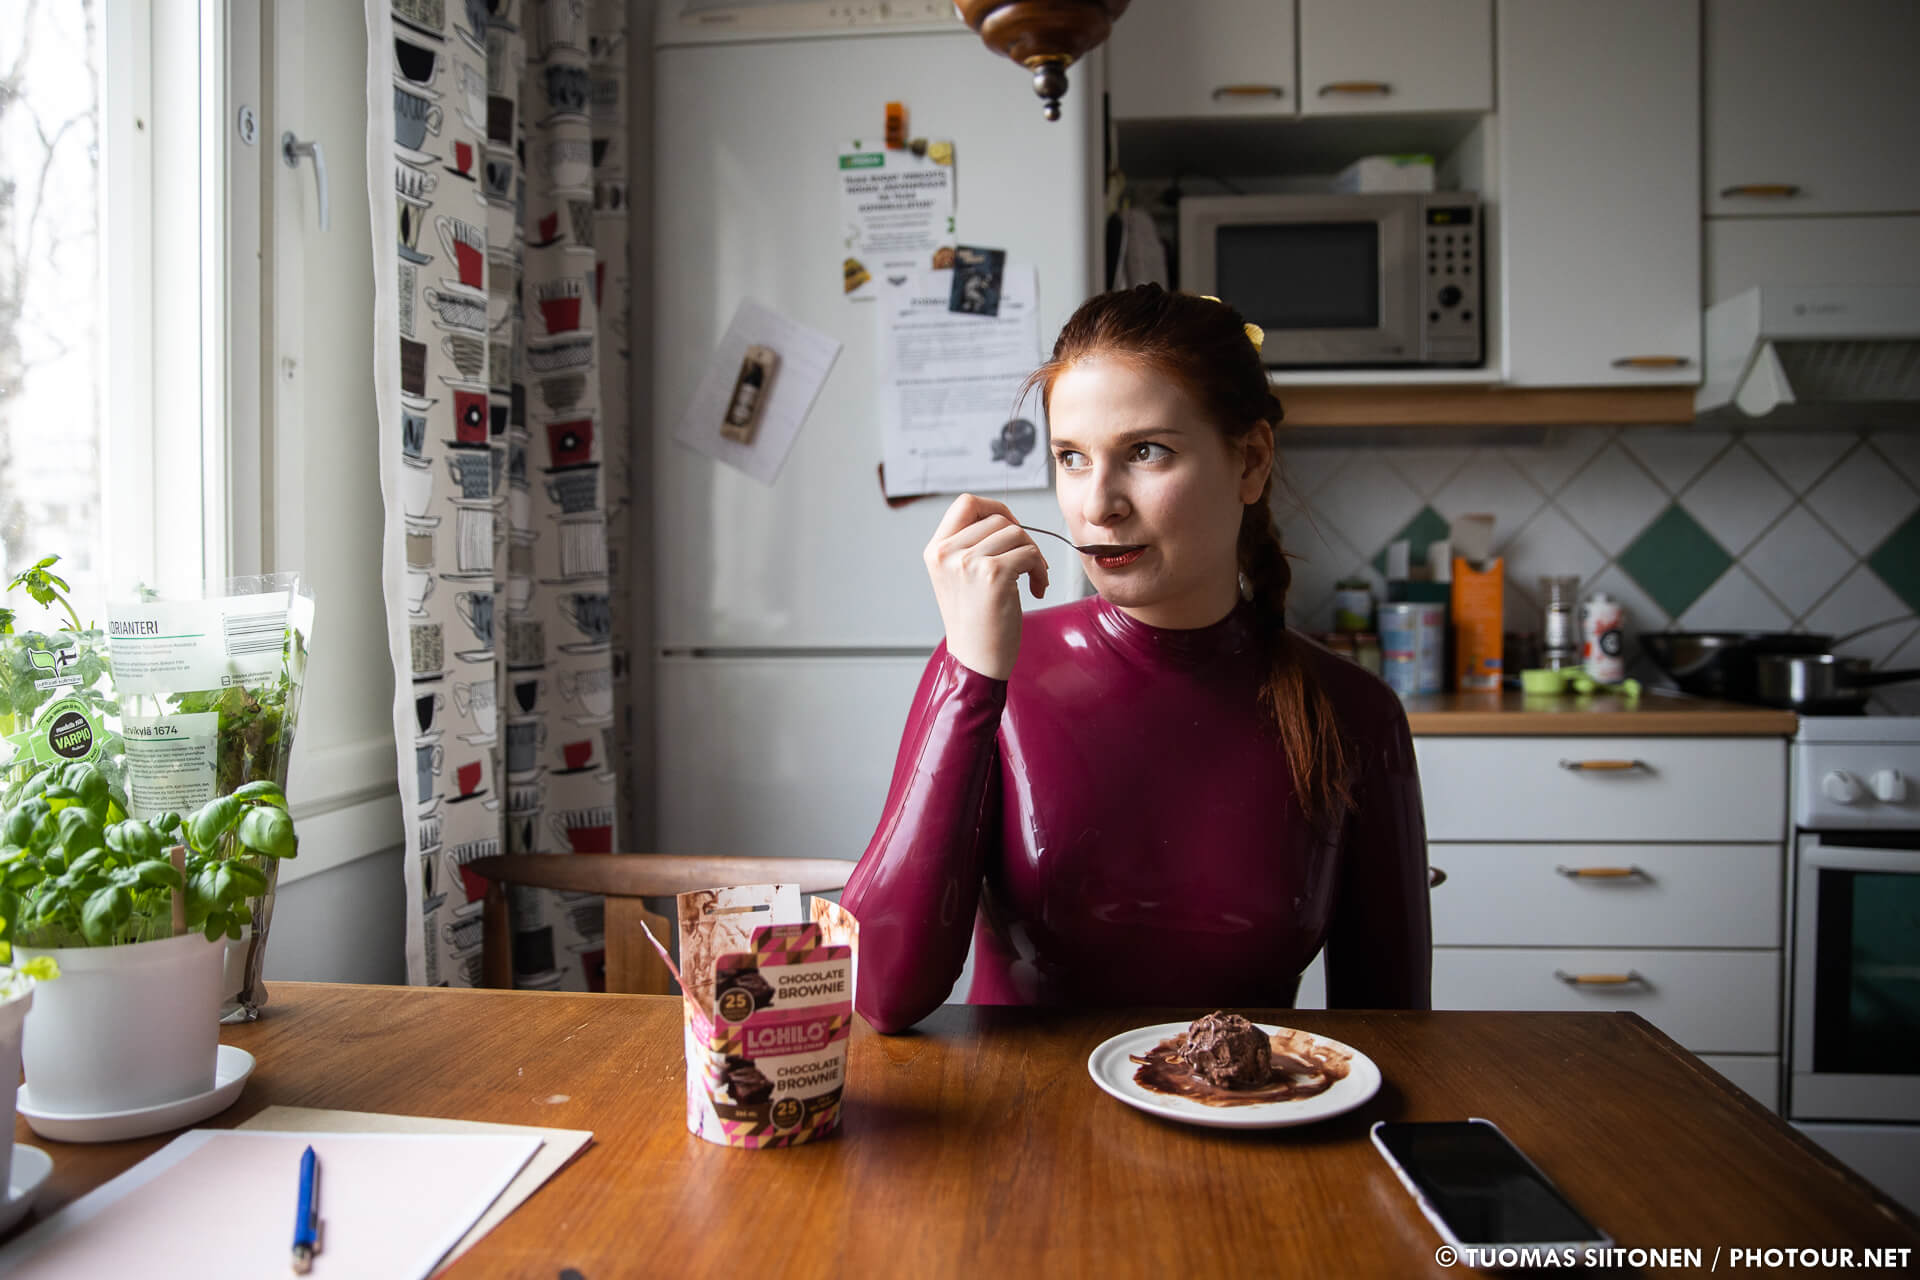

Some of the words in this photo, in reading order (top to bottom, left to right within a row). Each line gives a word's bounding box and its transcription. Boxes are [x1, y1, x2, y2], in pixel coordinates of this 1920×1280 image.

[109, 620, 159, 635] ORIANTERI
[55, 727, 91, 750] VARPIO
[153, 725, 178, 736] 1674
[778, 968, 845, 985] CHOCOLATE
[778, 980, 845, 1000] BROWNIE
[725, 994, 747, 1009] 25
[747, 1022, 825, 1049] LOHILO
[776, 1056, 840, 1078] CHOCOLATE
[776, 1068, 839, 1092] BROWNIE
[777, 1101, 798, 1116] 25
